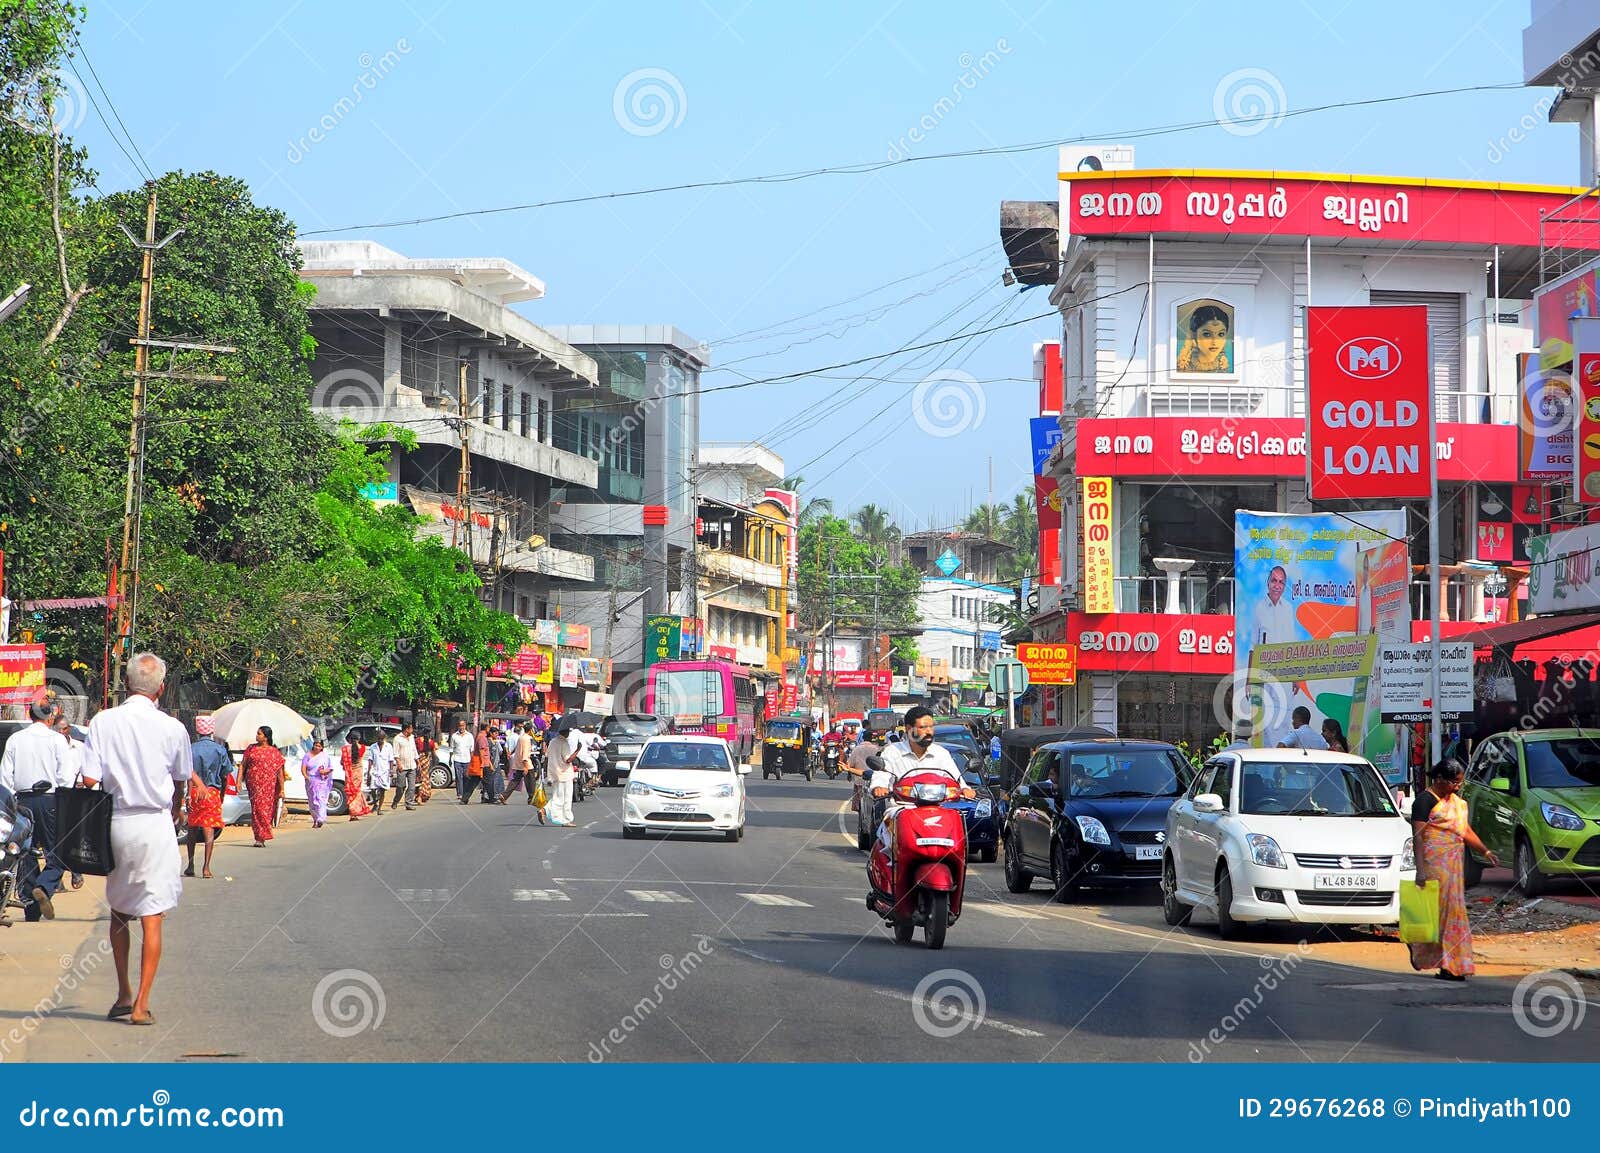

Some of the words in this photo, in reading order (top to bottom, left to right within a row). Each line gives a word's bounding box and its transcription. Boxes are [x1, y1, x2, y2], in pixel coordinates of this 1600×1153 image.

[1079, 192, 1163, 217] ജനത
[1186, 187, 1288, 225] സൂപ്പർ
[1323, 400, 1419, 428] GOLD
[1094, 434, 1153, 454] ജനത
[1325, 445, 1419, 475] LOAN
[1088, 481, 1109, 541] ജനത
[1079, 631, 1160, 652] ജനത
[1286, 642, 1331, 662] DAMAKA
[1026, 646, 1068, 661] ജനത
[1322, 876, 1333, 886] KL
[1334, 876, 1346, 886] 48
[1347, 876, 1353, 885] B
[1354, 875, 1376, 885] 4848
